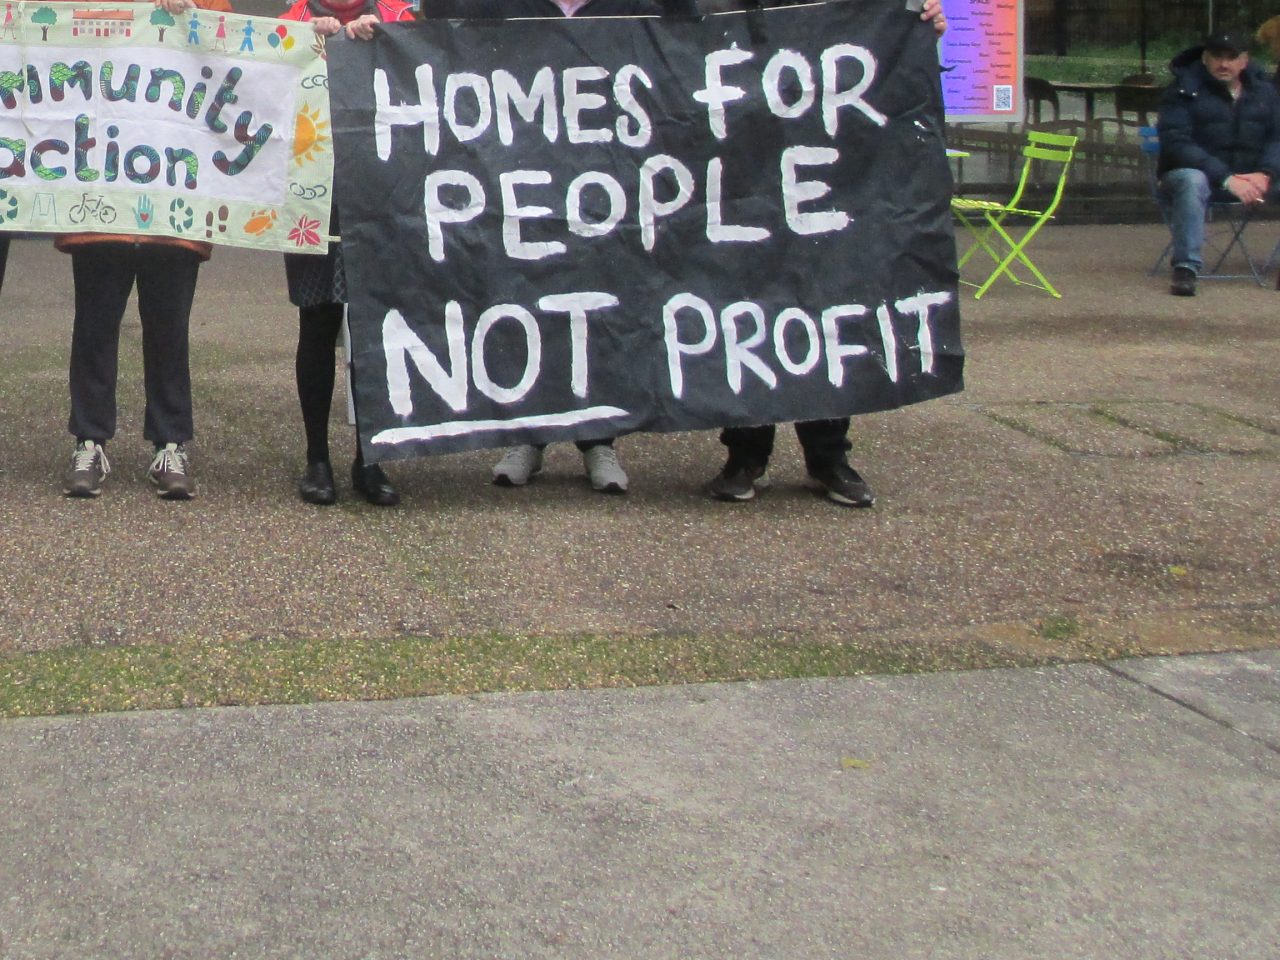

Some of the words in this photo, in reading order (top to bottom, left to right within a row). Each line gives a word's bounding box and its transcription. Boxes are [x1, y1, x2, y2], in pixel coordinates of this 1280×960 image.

[373, 63, 653, 162] HOMES
[693, 42, 888, 140] FOR
[423, 145, 854, 263] PEOPLE
[381, 291, 619, 418] NOT
[662, 290, 952, 399] PROFIT
